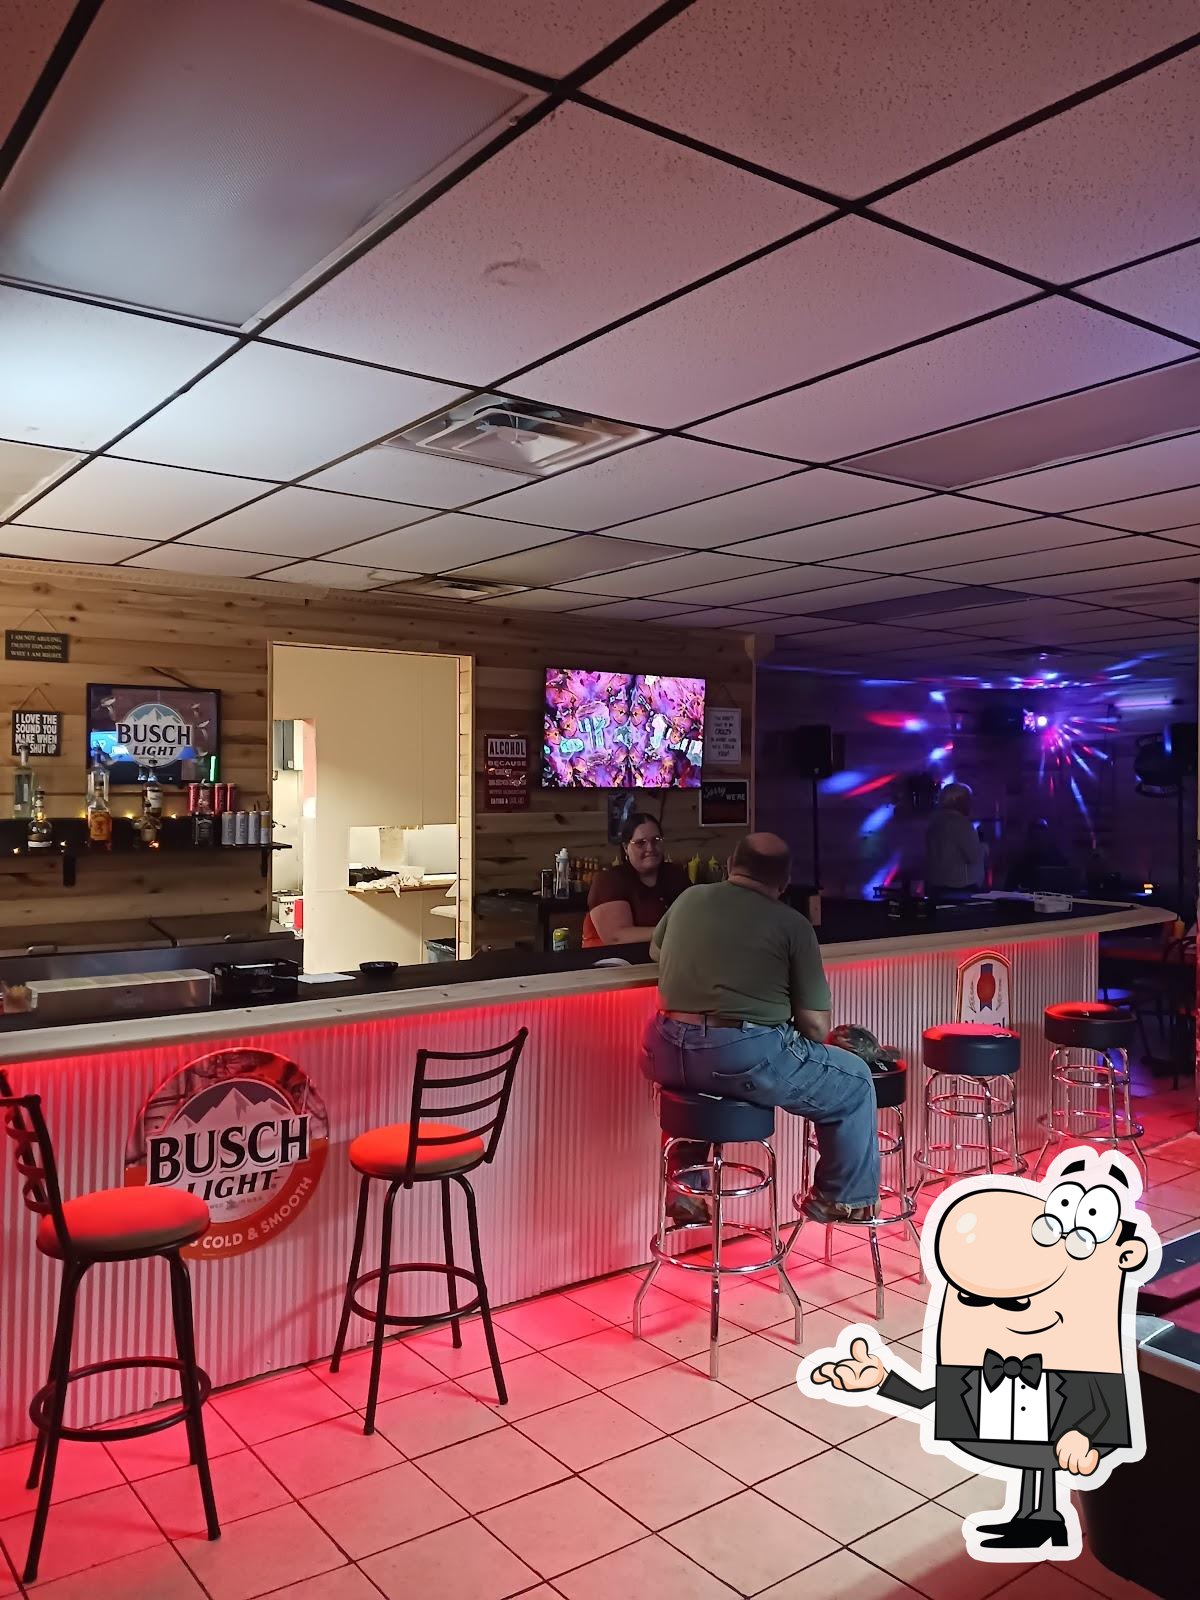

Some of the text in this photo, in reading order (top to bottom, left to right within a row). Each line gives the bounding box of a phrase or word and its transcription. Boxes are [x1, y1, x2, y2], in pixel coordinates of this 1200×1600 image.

[15, 713, 58, 725] I LOVE THE
[15, 723, 57, 735] SOUND YOU
[116, 722, 192, 746] BUSCH
[15, 733, 58, 745] MAKE WHEN
[29, 743, 46, 754] SHUT
[47, 744, 57, 754] UP
[133, 745, 176, 757] LIGHT
[489, 741, 526, 756] ALCOHOL
[487, 760, 527, 768] BECAUSE
[149, 1115, 309, 1186] BUSCH
[187, 1168, 278, 1202] LIGHT
[202, 1233, 244, 1250] COLD
[247, 1226, 259, 1241] &
[261, 1176, 314, 1234] SMOOTH
